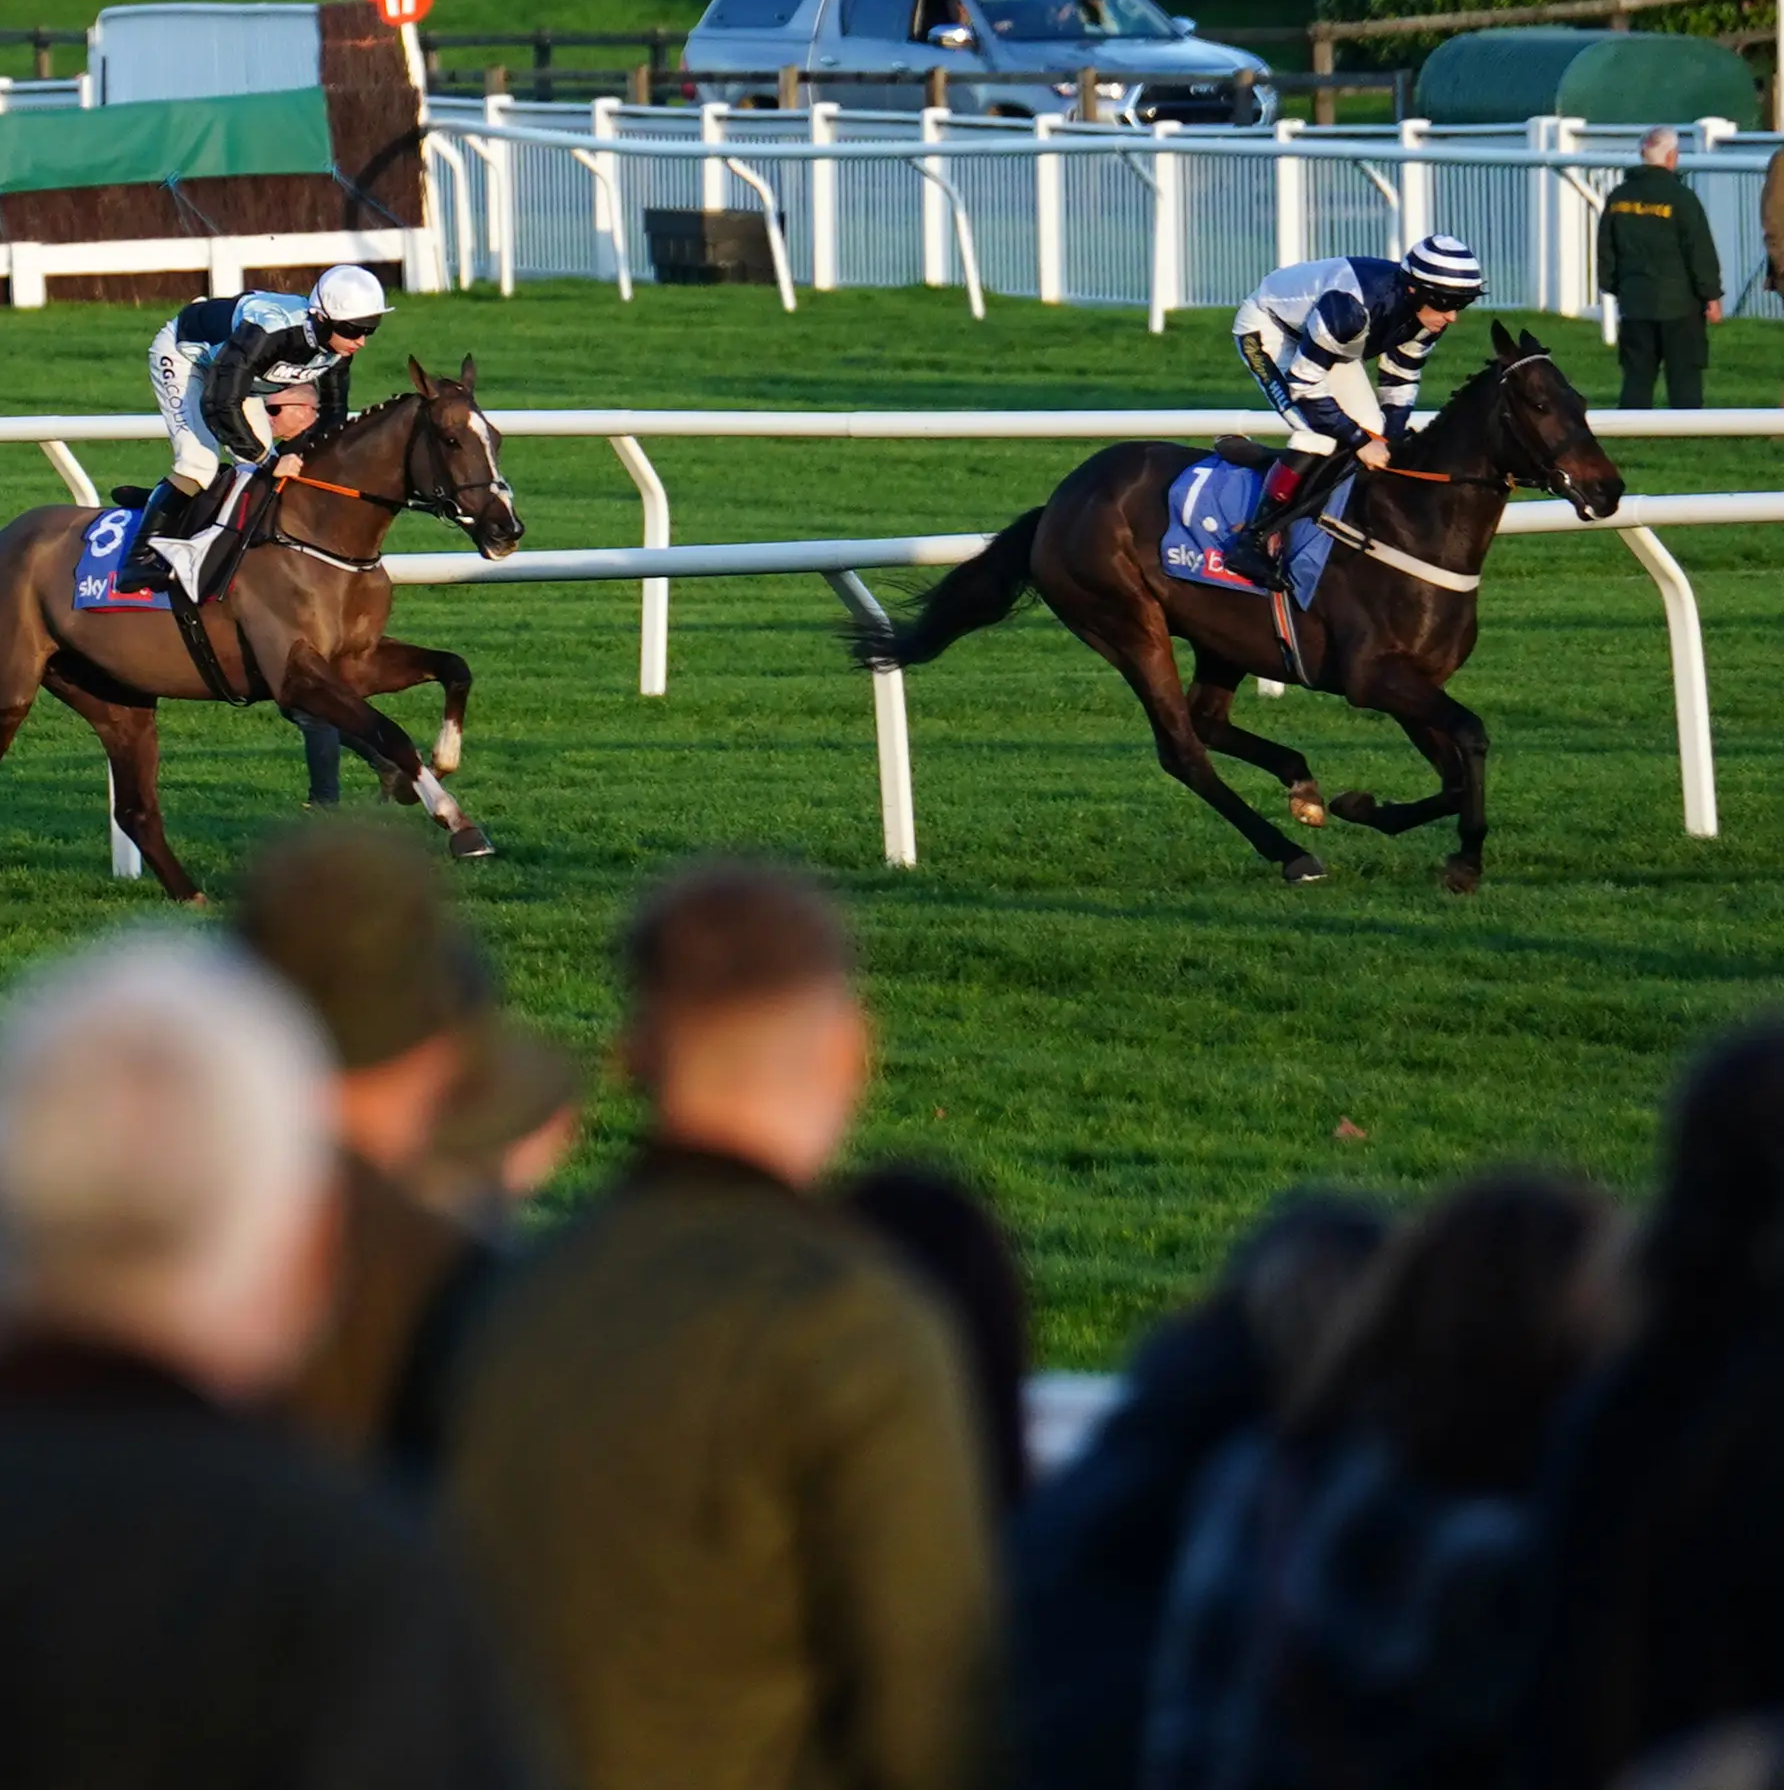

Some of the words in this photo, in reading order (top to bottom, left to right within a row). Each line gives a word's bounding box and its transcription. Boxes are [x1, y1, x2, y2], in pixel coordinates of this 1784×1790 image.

[88, 509, 133, 557] 8
[1167, 543, 1204, 573] sky
[78, 575, 108, 600] sky
